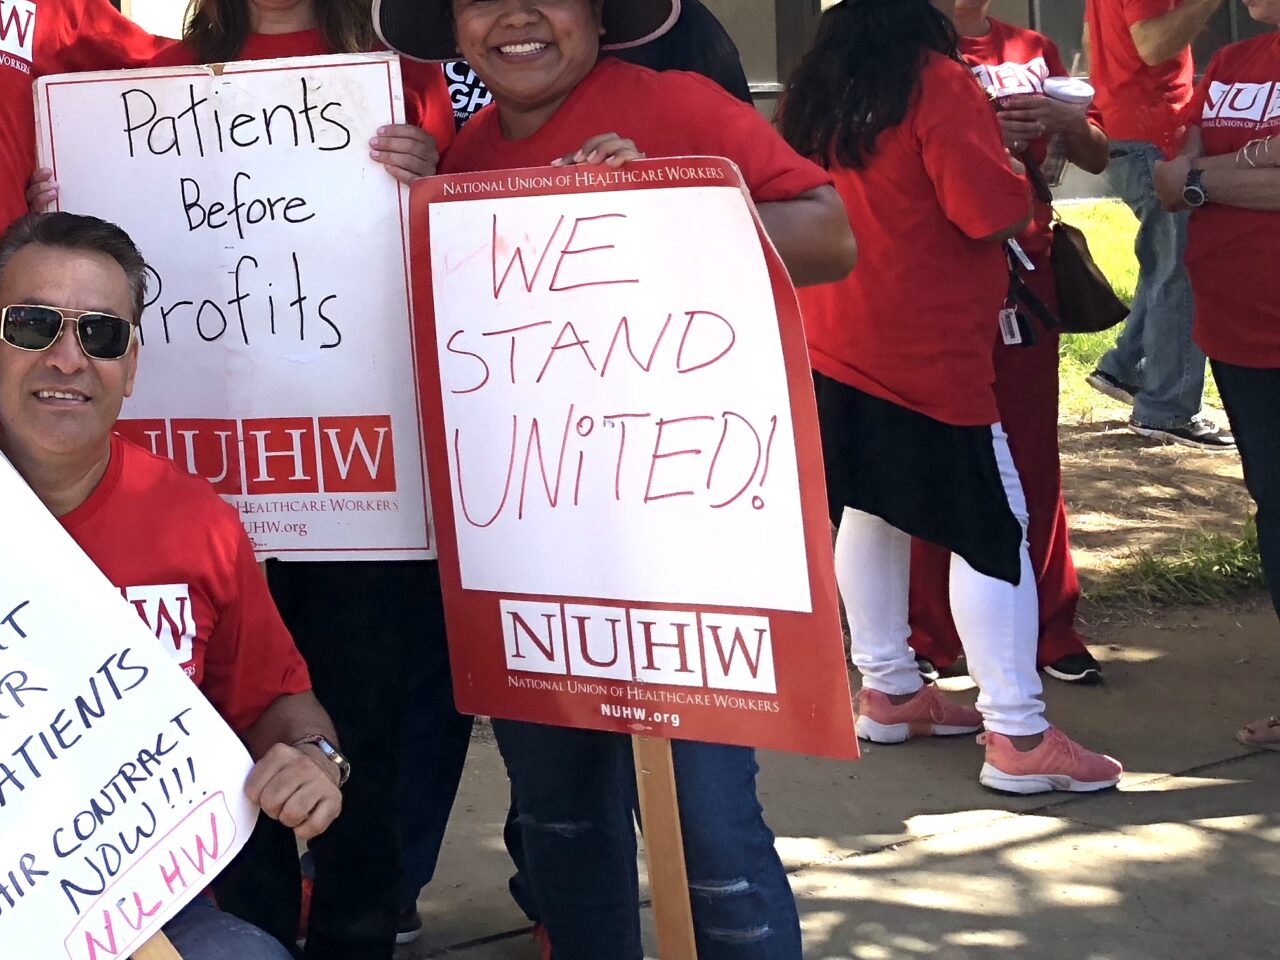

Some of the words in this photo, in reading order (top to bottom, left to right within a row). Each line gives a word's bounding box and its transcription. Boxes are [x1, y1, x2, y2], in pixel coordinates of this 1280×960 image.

[120, 77, 351, 158] Patients
[180, 172, 315, 239] Before
[443, 178, 506, 196] NATIONAL
[507, 175, 553, 191] UNION
[556, 175, 572, 186] OF
[575, 170, 663, 188] HEALTHCARE
[665, 166, 725, 181] WORKERS
[491, 213, 639, 299] WE
[447, 310, 736, 394] STAND
[236, 498, 326, 514] HEALTHCARE
[328, 498, 399, 512] WORKERS
[506, 610, 768, 681] NUHW
[508, 675, 565, 692] NATIONAL
[567, 680, 608, 696] UNION
[609, 686, 624, 697] OF
[626, 686, 711, 706] HEALTHCARE
[712, 693, 780, 713] WORKERS
[600, 703, 680, 727] NUHW.org
[53, 707, 193, 859] CONTRACT
